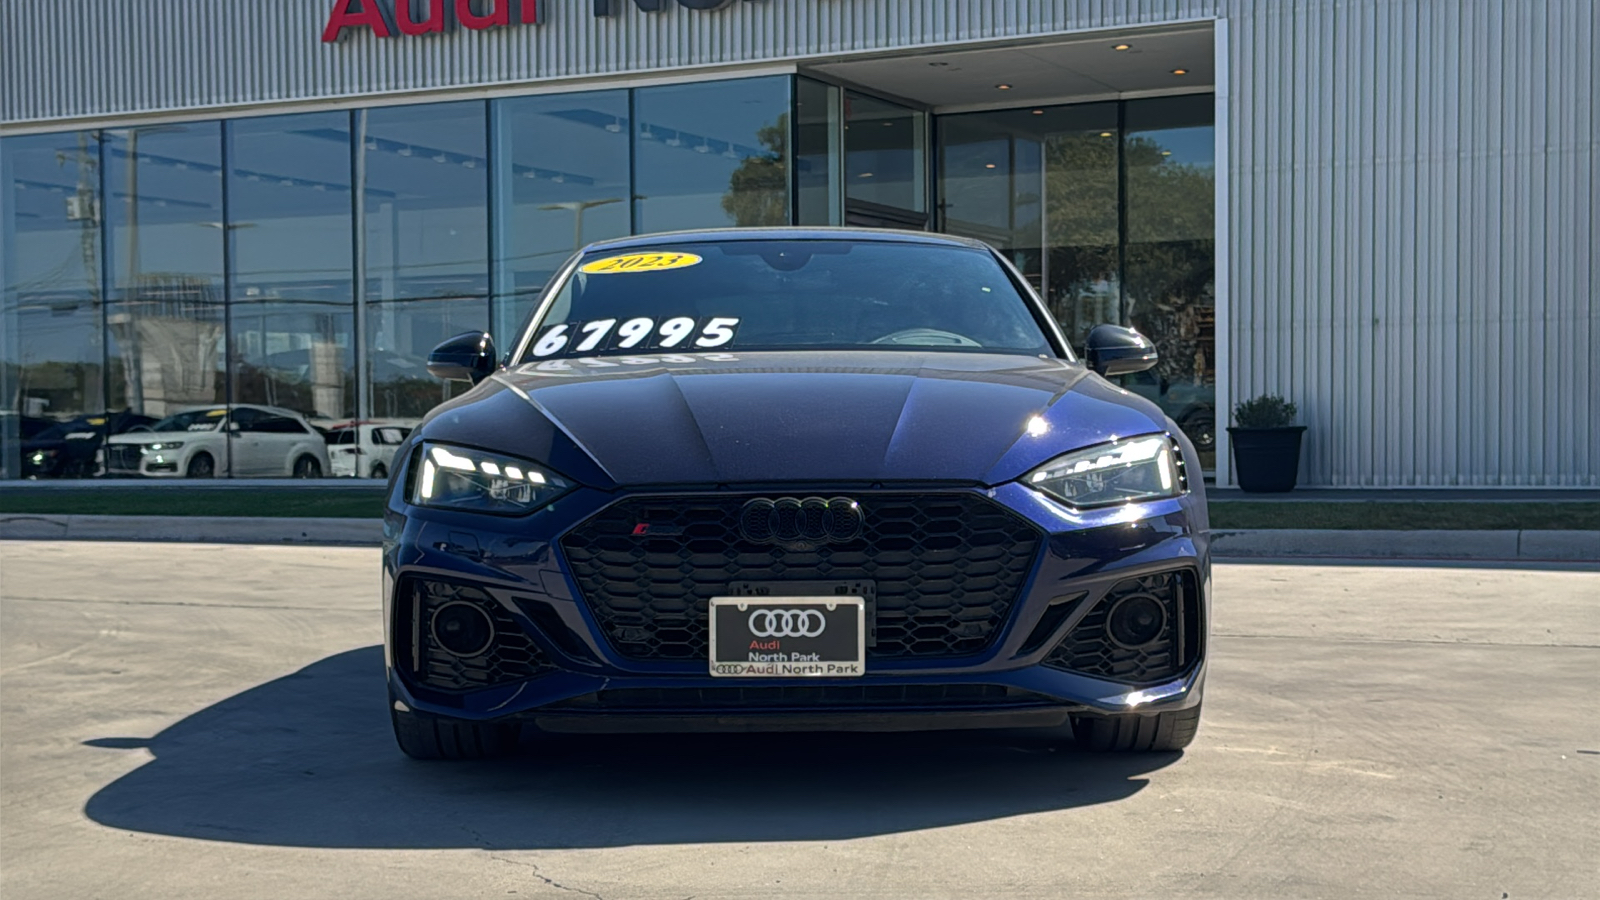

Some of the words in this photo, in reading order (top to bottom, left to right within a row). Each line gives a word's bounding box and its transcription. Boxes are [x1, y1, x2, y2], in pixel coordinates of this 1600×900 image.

[599, 254, 682, 271] 2023
[532, 317, 740, 356] 67995
[750, 640, 780, 650] Audi
[748, 652, 788, 662] North
[791, 652, 820, 662] Park
[746, 664, 778, 675] Audi
[782, 663, 823, 674] North
[827, 663, 858, 674] Park
